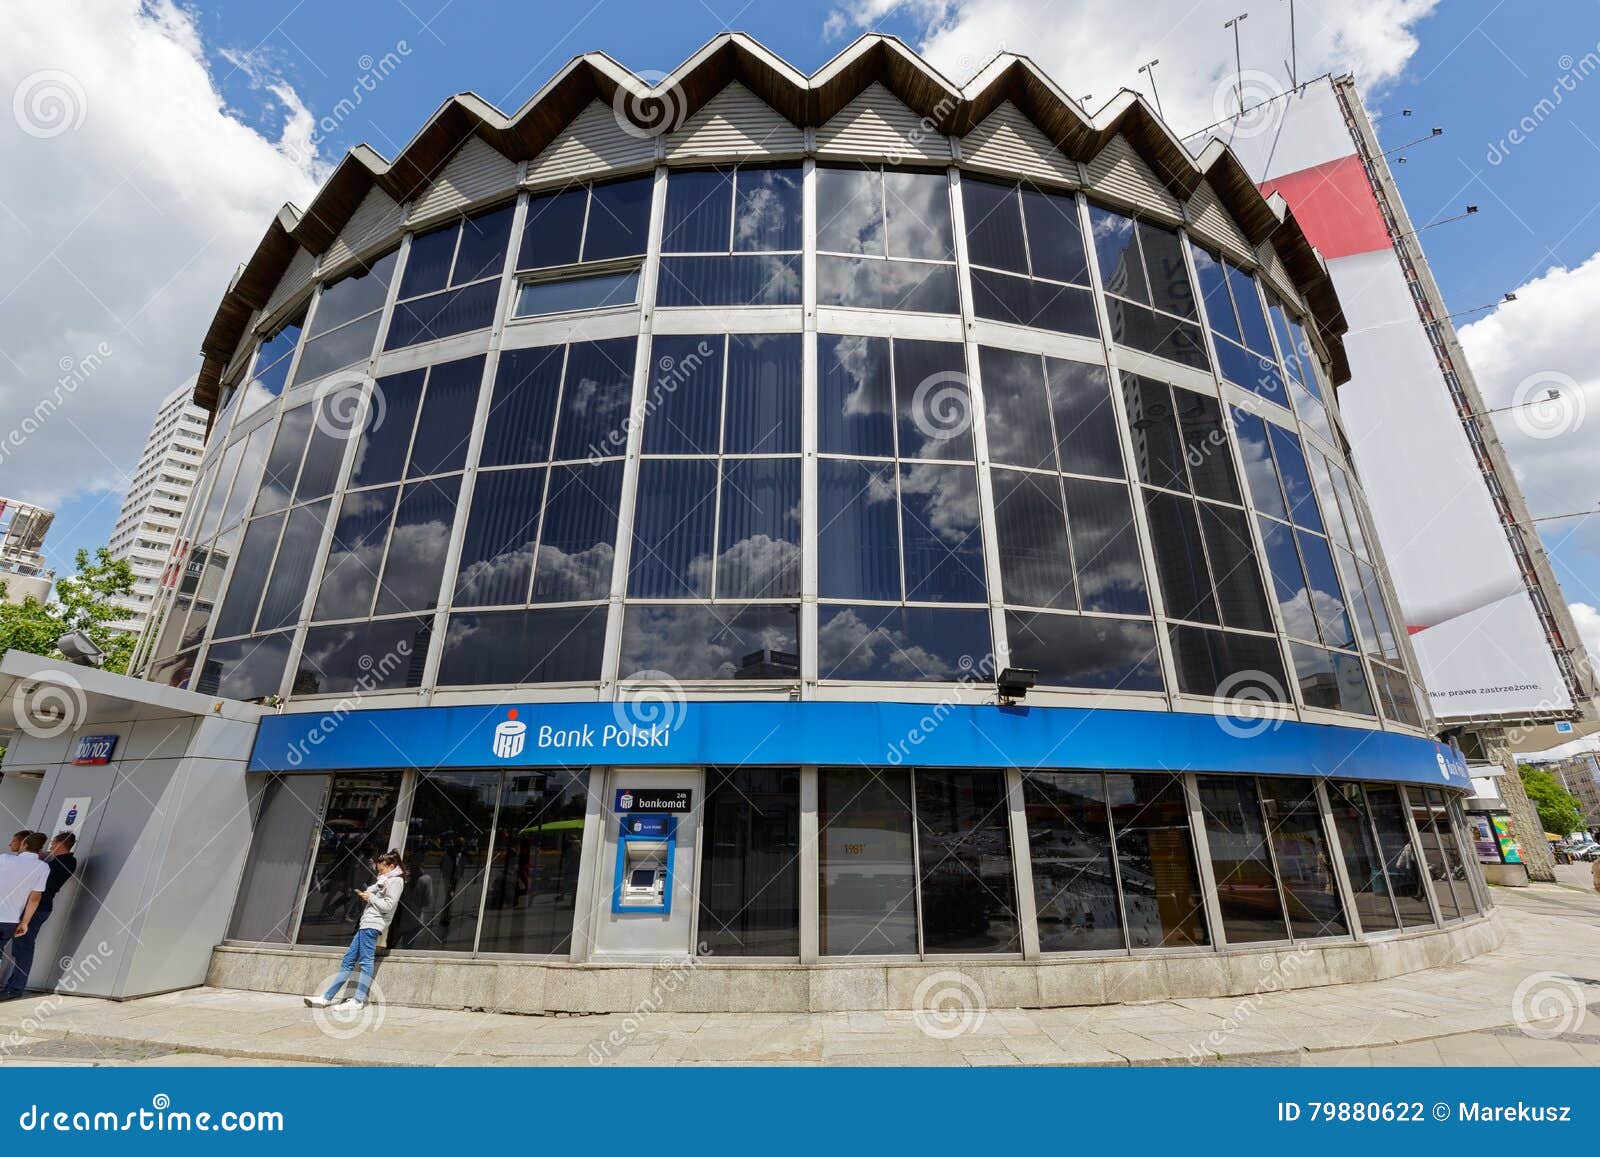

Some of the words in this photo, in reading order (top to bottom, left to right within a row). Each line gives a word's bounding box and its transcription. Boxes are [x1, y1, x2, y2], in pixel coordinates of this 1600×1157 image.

[1447, 688, 1477, 698] prawa
[538, 724, 594, 748] Bank
[602, 724, 670, 748] Polski
[639, 797, 686, 808] bankomat
